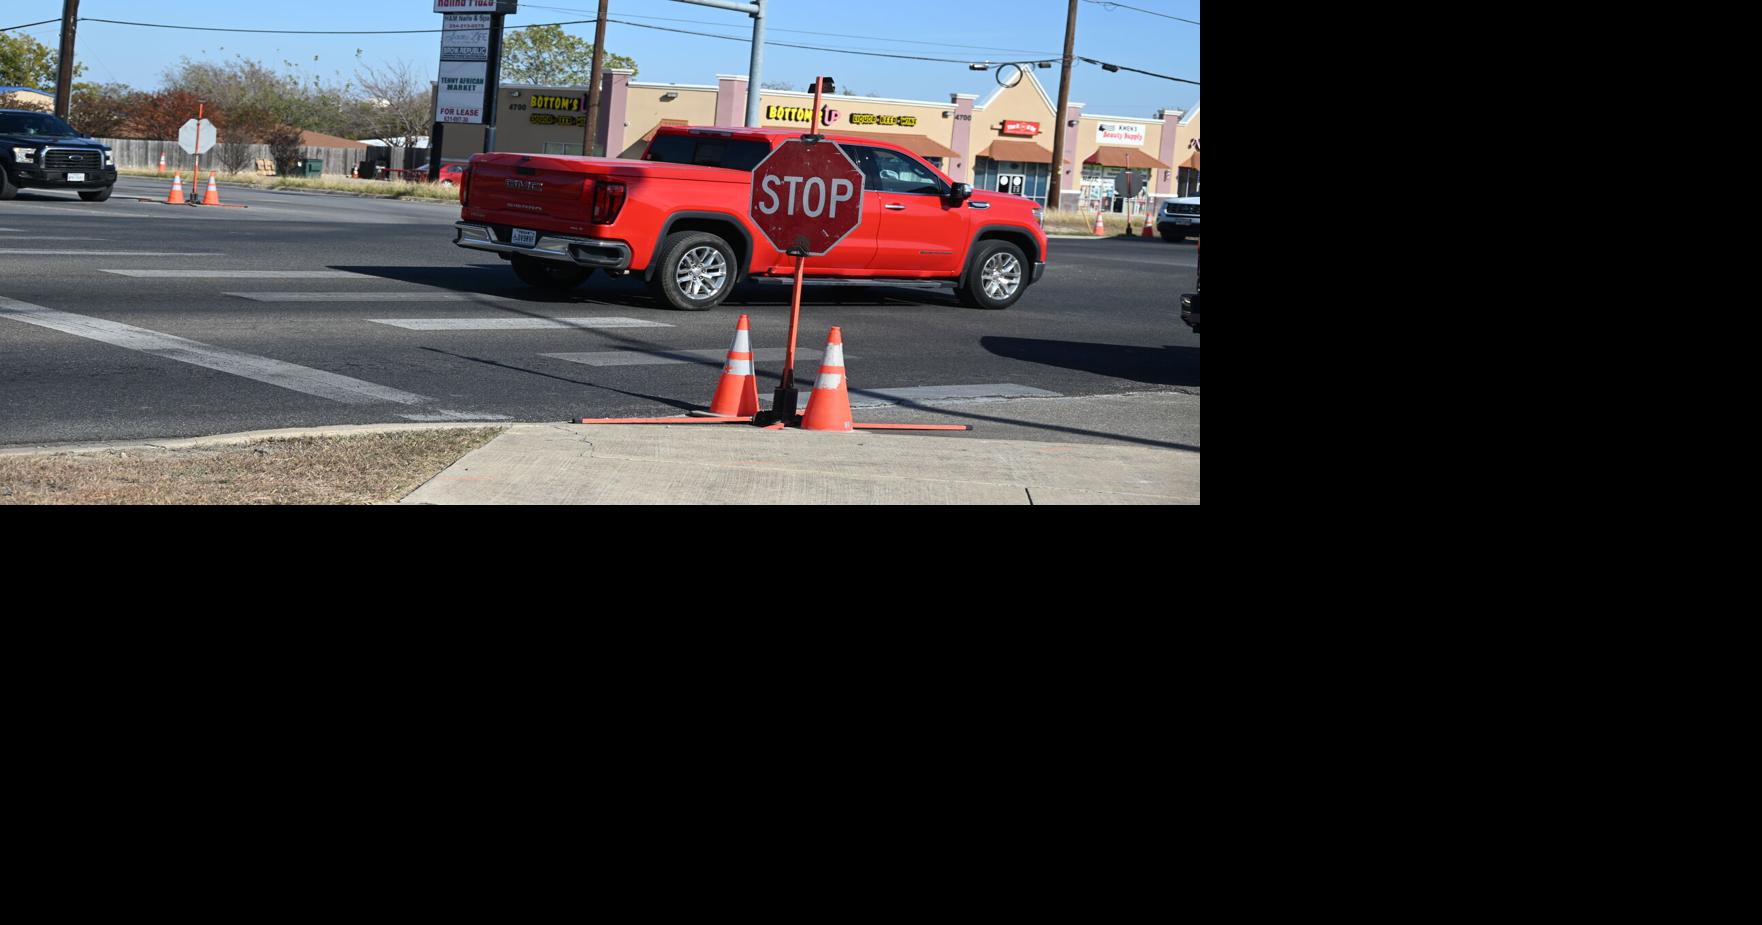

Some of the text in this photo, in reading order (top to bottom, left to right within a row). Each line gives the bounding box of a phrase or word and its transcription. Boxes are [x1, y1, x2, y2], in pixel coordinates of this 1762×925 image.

[530, 96, 579, 111] BOTTOM'S
[456, 108, 480, 116] LEASE
[767, 105, 823, 122] BOTTOMS
[1103, 131, 1143, 141] Beauty Supply
[758, 175, 854, 219] STOP
